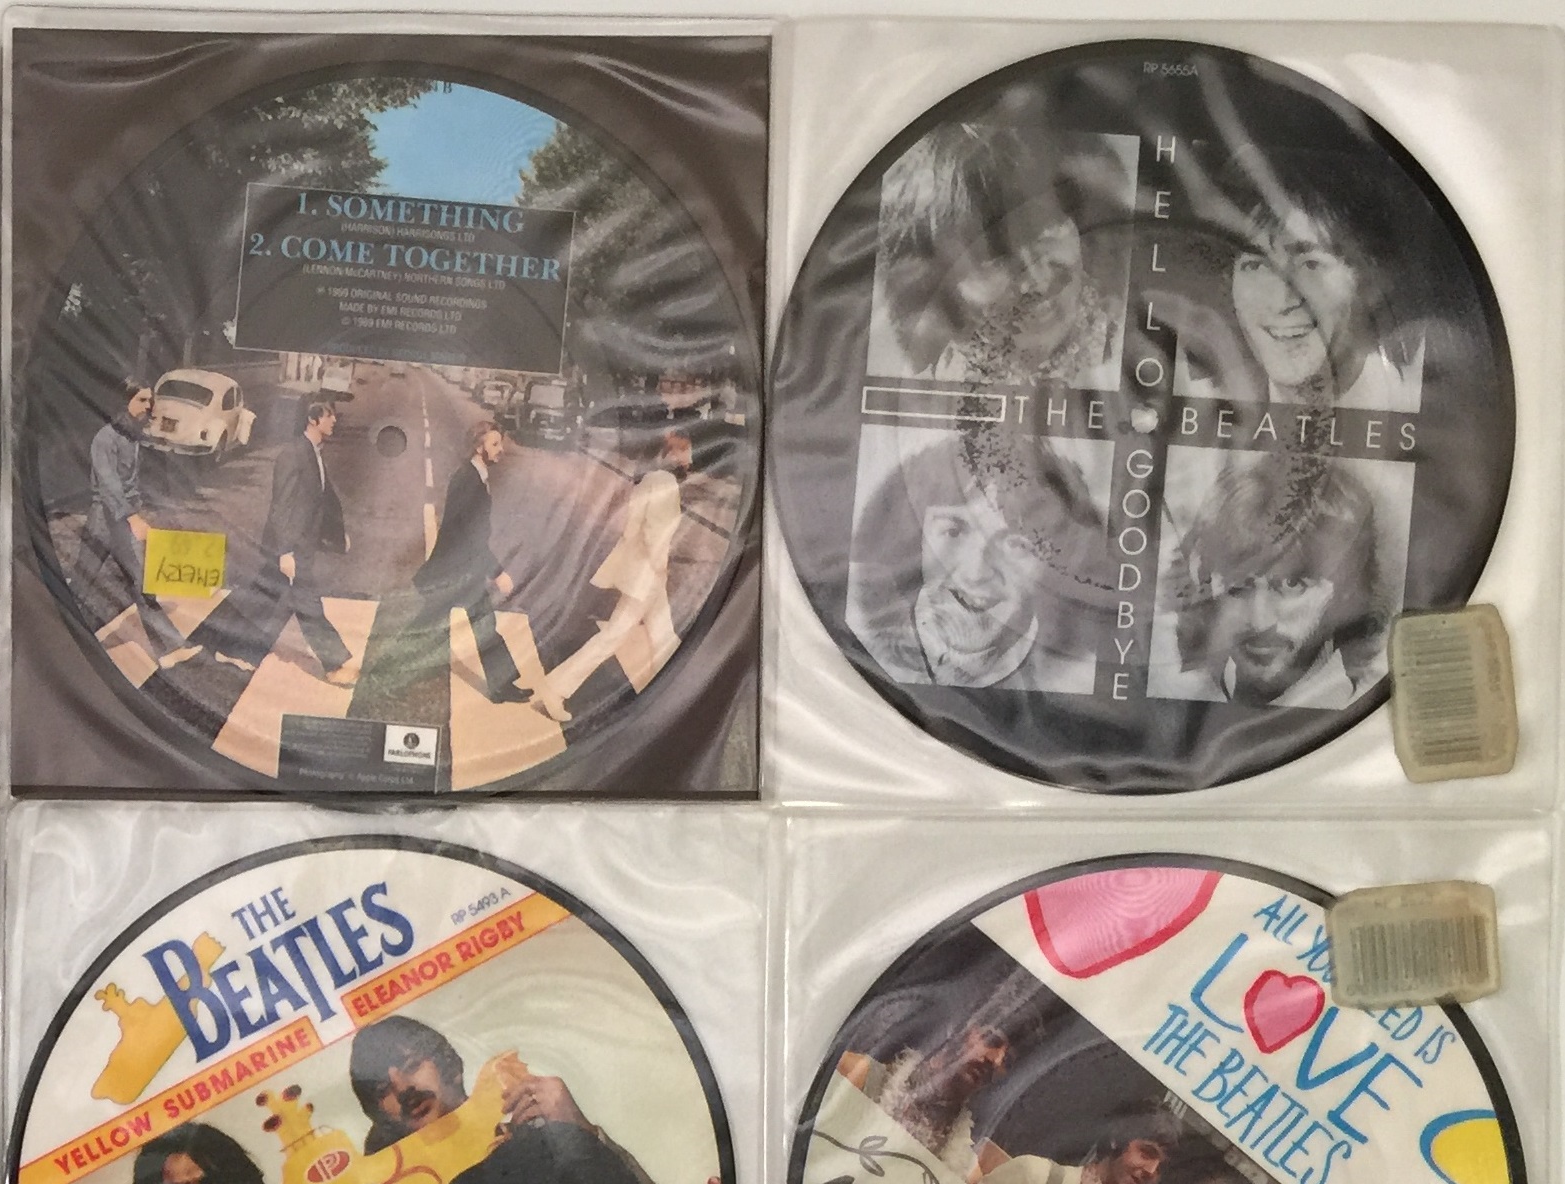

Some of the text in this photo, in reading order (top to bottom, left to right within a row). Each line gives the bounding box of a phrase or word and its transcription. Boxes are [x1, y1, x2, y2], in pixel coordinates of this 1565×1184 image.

[298, 192, 525, 234] 1. SOMETHING
[248, 232, 562, 281] 2. COME TOGETHER
[350, 289, 393, 301] ORIGINAL
[395, 292, 428, 304] SOUND
[429, 295, 488, 309] RECORDINGS
[487, 279, 506, 290] LTD
[339, 301, 365, 313] MADE
[444, 309, 462, 321] LTD
[395, 320, 437, 333] RECORDS
[438, 323, 457, 335] LTD
[1014, 394, 1417, 452] THE BEATLES
[230, 886, 296, 941] THE
[450, 908, 467, 926] RP
[500, 887, 511, 900] A
[142, 881, 415, 1063] BEATLES
[351, 911, 525, 1017] ELEANOR RIGBY
[1142, 1003, 1221, 1077] THE
[1413, 1025, 1456, 1065] IS
[54, 1028, 312, 1176] YELLOW SUBMARINE
